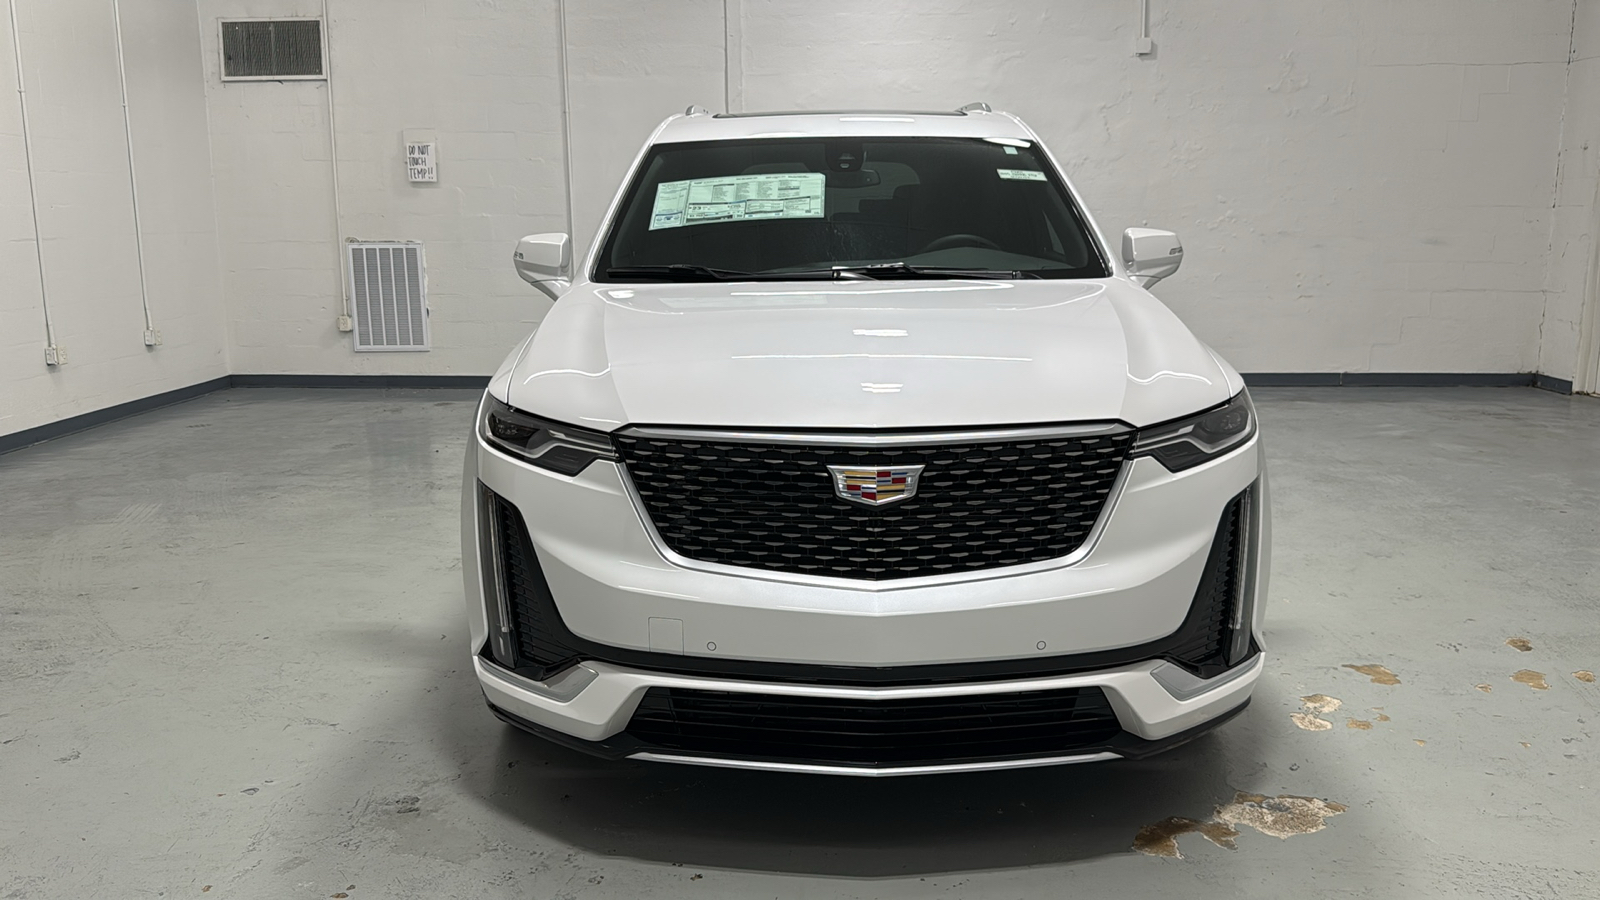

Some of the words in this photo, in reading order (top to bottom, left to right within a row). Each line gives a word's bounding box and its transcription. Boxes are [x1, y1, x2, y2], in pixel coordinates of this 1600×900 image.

[408, 145, 416, 156] DO
[417, 145, 431, 156] NOT
[408, 157, 427, 167] TOUCH
[409, 167, 434, 179] TEMP!!
